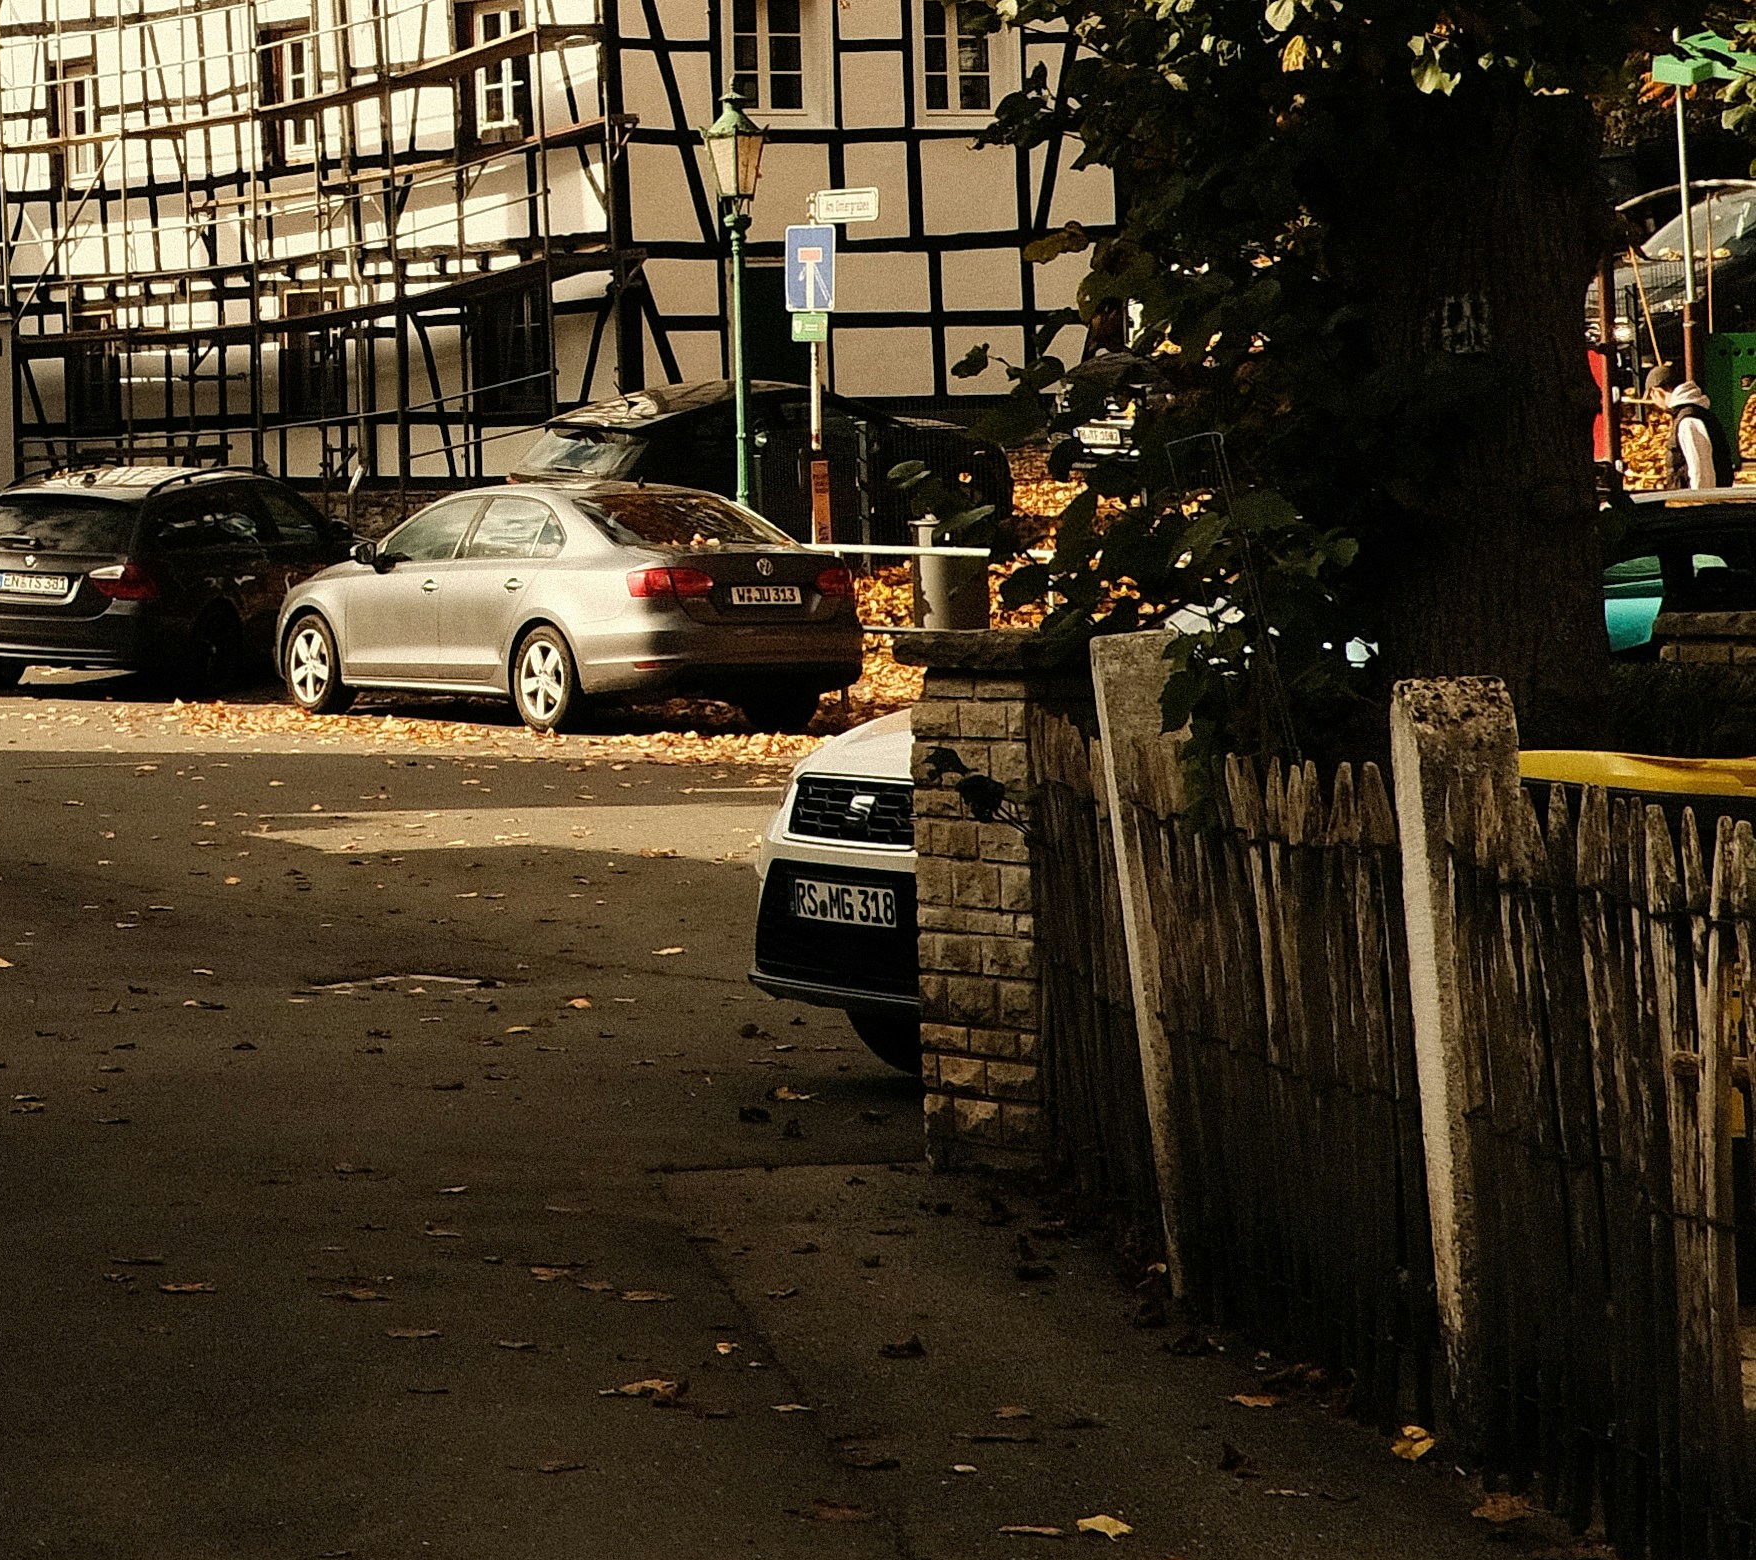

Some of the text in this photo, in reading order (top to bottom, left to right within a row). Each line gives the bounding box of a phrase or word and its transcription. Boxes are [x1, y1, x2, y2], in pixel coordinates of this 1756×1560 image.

[736, 588, 796, 602] W JU 313
[796, 882, 895, 925] RS MG 318
